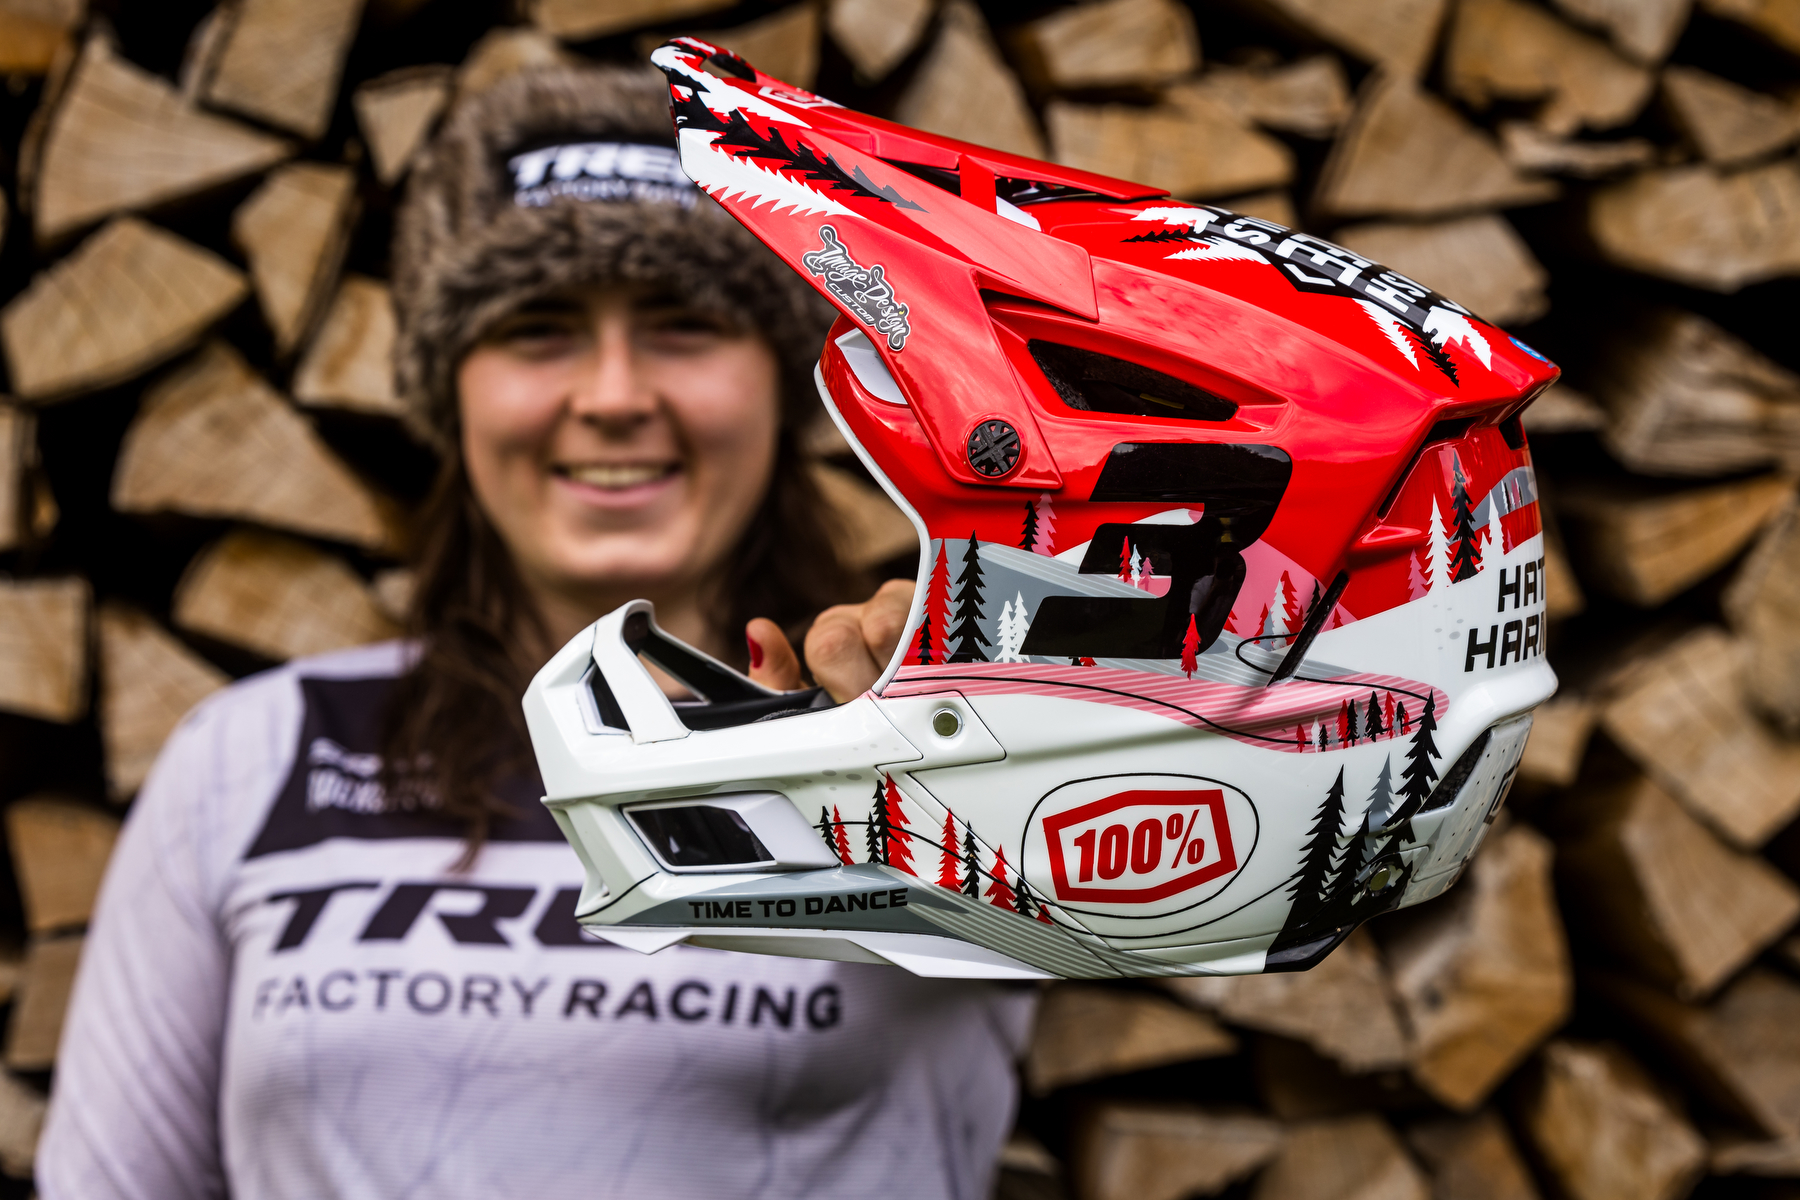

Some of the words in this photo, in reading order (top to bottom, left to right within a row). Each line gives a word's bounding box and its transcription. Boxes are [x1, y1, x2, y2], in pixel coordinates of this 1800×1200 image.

[829, 283, 875, 322] CUSTOM
[854, 269, 906, 346] Design
[1073, 809, 1205, 883] 100%
[688, 901, 752, 919] TIME
[758, 899, 796, 917] TO
[804, 887, 908, 915] DANCE
[252, 966, 549, 1021] FACTORY
[562, 980, 843, 1031] RACING
